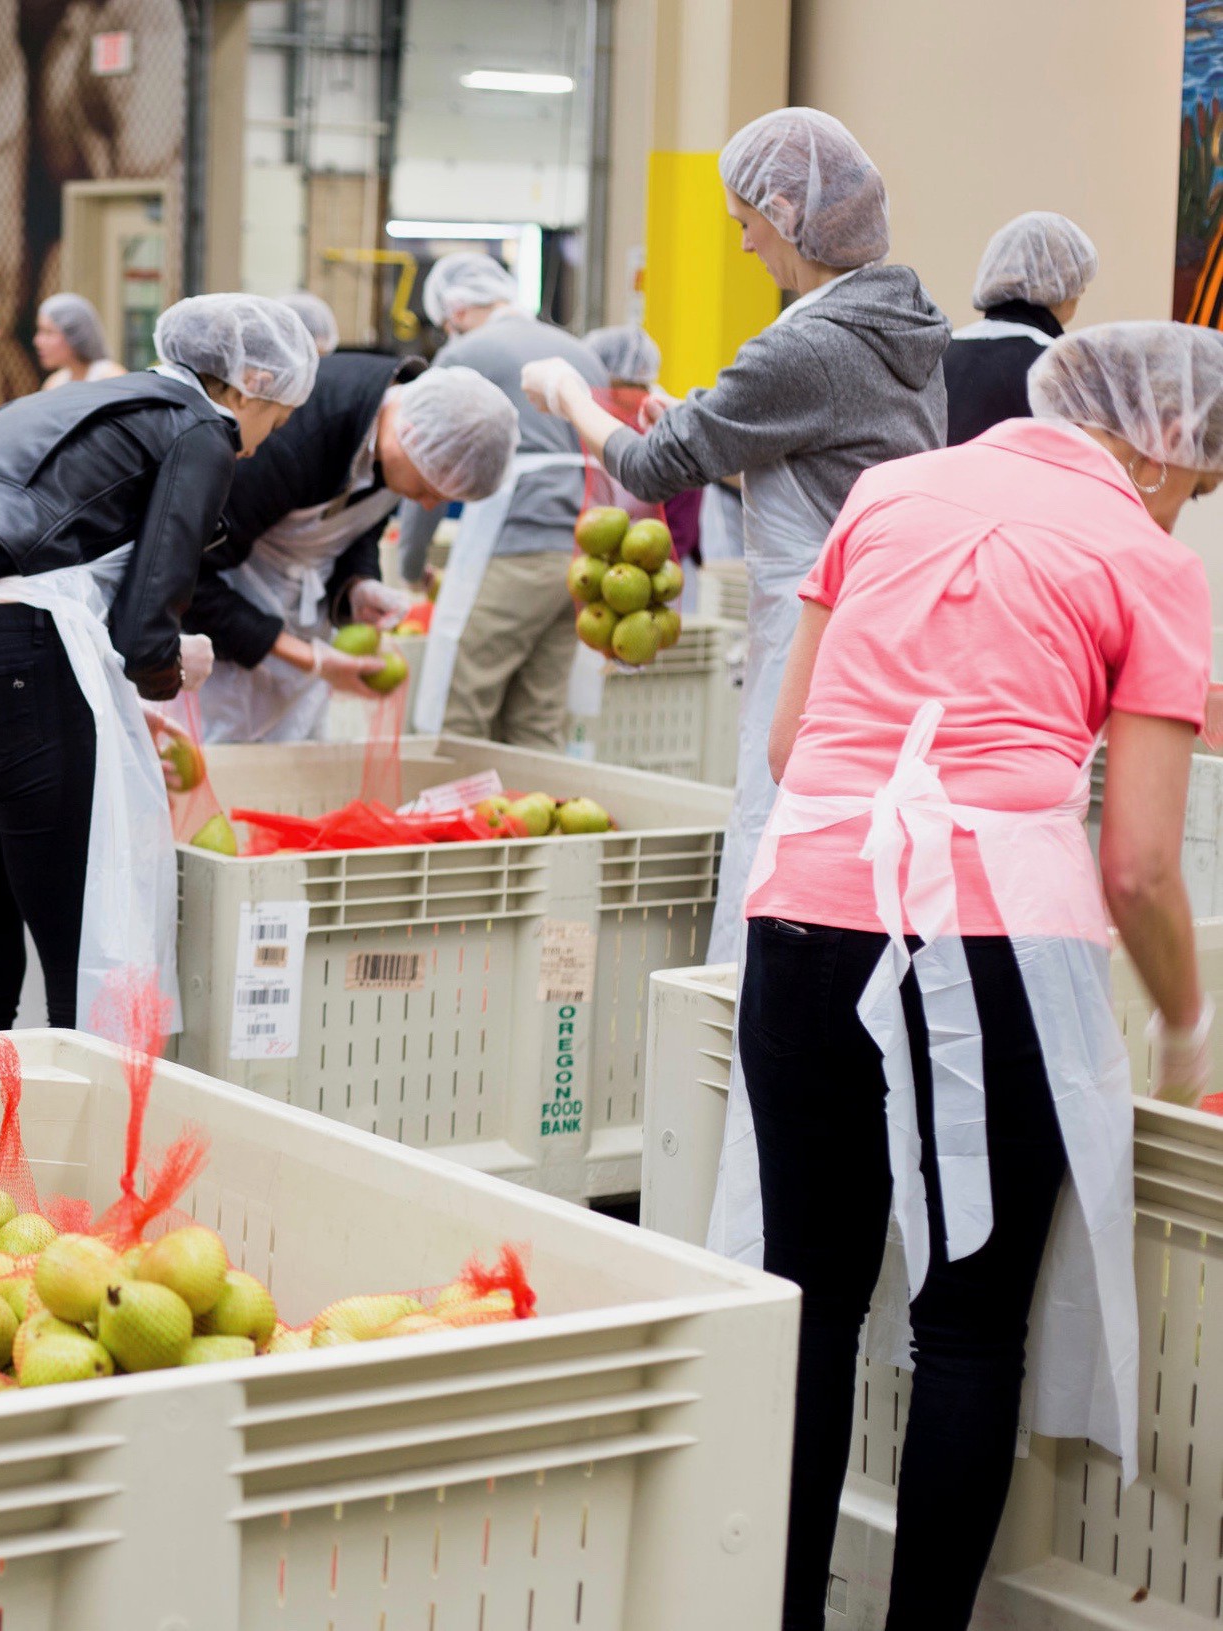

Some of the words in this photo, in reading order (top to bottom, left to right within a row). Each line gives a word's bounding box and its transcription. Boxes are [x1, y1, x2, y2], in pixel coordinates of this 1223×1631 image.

[555, 1005, 576, 1100] OREGON
[541, 1100, 583, 1118] FOOD
[540, 1119, 581, 1136] BANK
